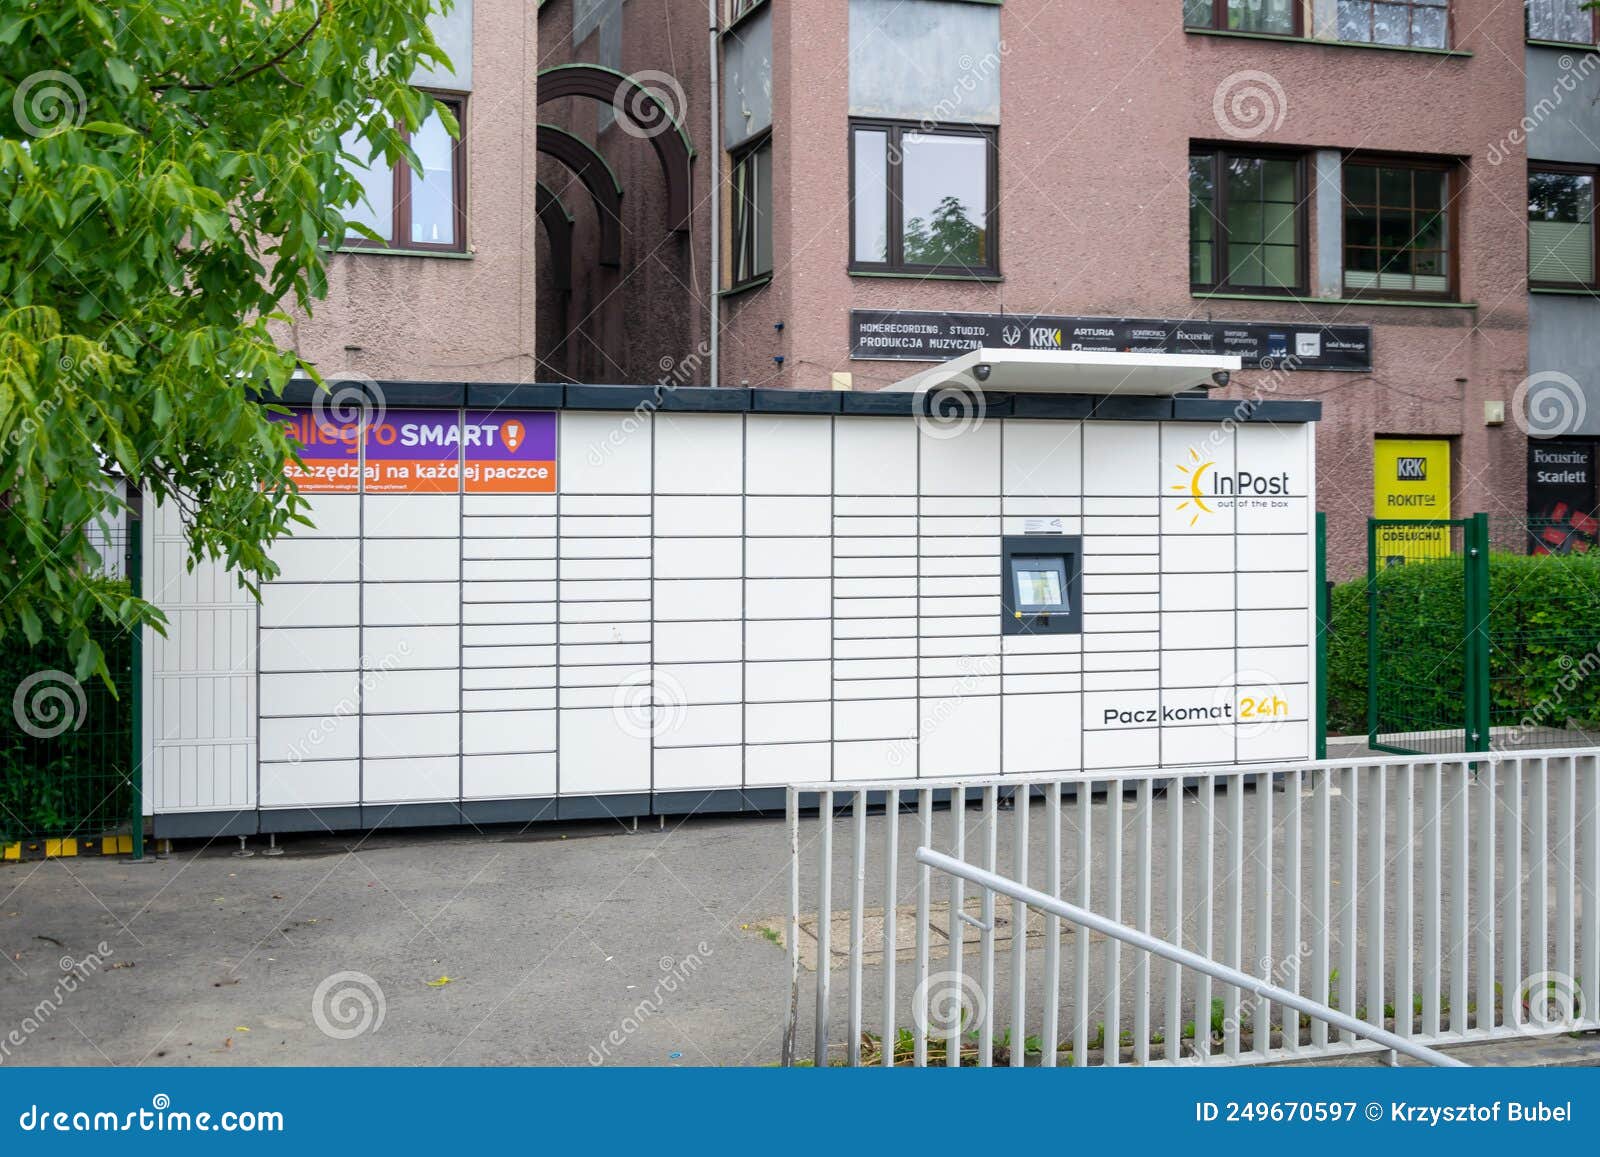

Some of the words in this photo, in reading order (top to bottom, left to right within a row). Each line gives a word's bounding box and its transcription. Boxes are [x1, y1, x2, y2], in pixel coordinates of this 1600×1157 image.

[1030, 328, 1061, 347] KRK
[1074, 328, 1115, 337] ARTURIA
[860, 337, 923, 348] PRODUKCJA
[929, 339, 983, 349] MUZYCZNA
[284, 414, 397, 453] allegro
[1534, 450, 1588, 464] Focusrite
[283, 463, 380, 481] szczędzaj
[387, 465, 409, 479] na
[416, 463, 480, 482] każdej
[484, 466, 549, 482] paczce
[1397, 458, 1424, 476] KRK
[1213, 471, 1289, 495] InPost
[1537, 471, 1587, 483] Scarlett
[1217, 500, 1234, 508] out
[1239, 499, 1248, 508] of
[1252, 500, 1267, 508] the
[1271, 500, 1289, 508] box
[1239, 696, 1290, 718] 24h
